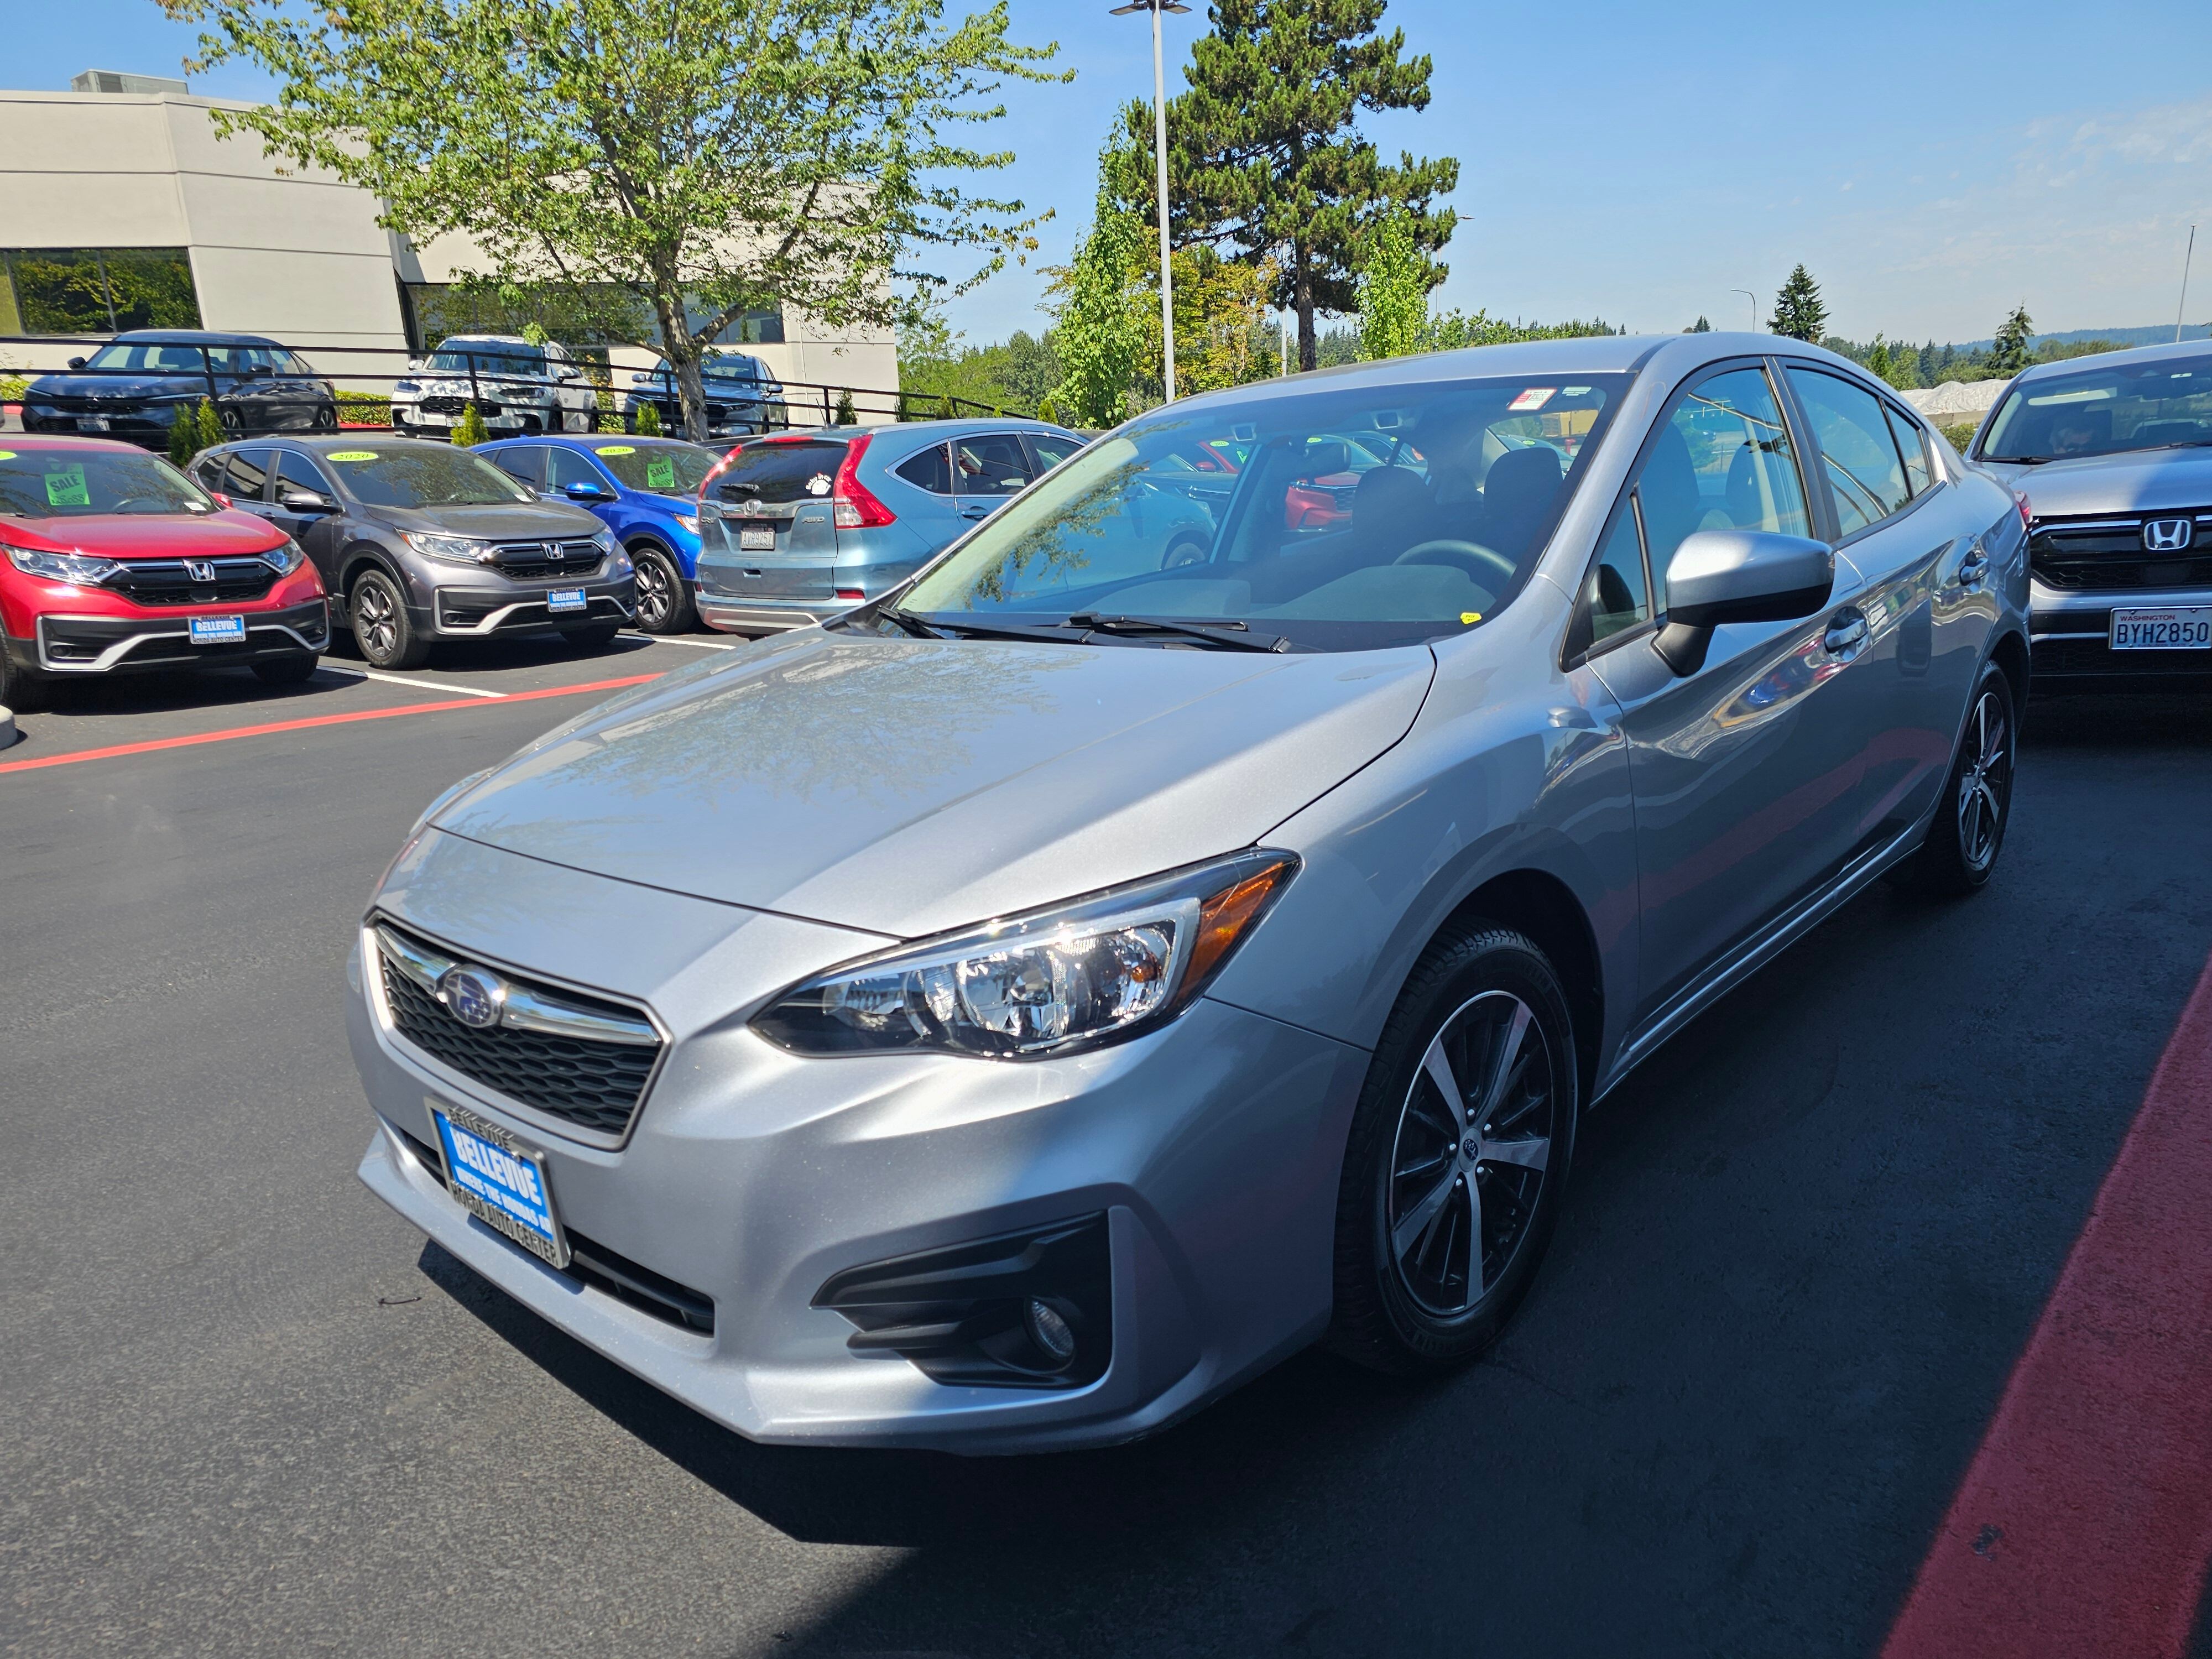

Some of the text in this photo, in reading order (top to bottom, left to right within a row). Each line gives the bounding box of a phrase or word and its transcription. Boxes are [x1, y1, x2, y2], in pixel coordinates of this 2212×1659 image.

[650, 465, 670, 478] SALE
[50, 474, 81, 492] SALE
[552, 592, 581, 602] BELLEVUE
[195, 620, 238, 632] BELLEVUE
[2117, 622, 2209, 644] BYH2850
[448, 1106, 514, 1151] BELLEVUE
[449, 1125, 542, 1207] BELLEVUE
[450, 1180, 559, 1267] HONDA AUTO CENTER
